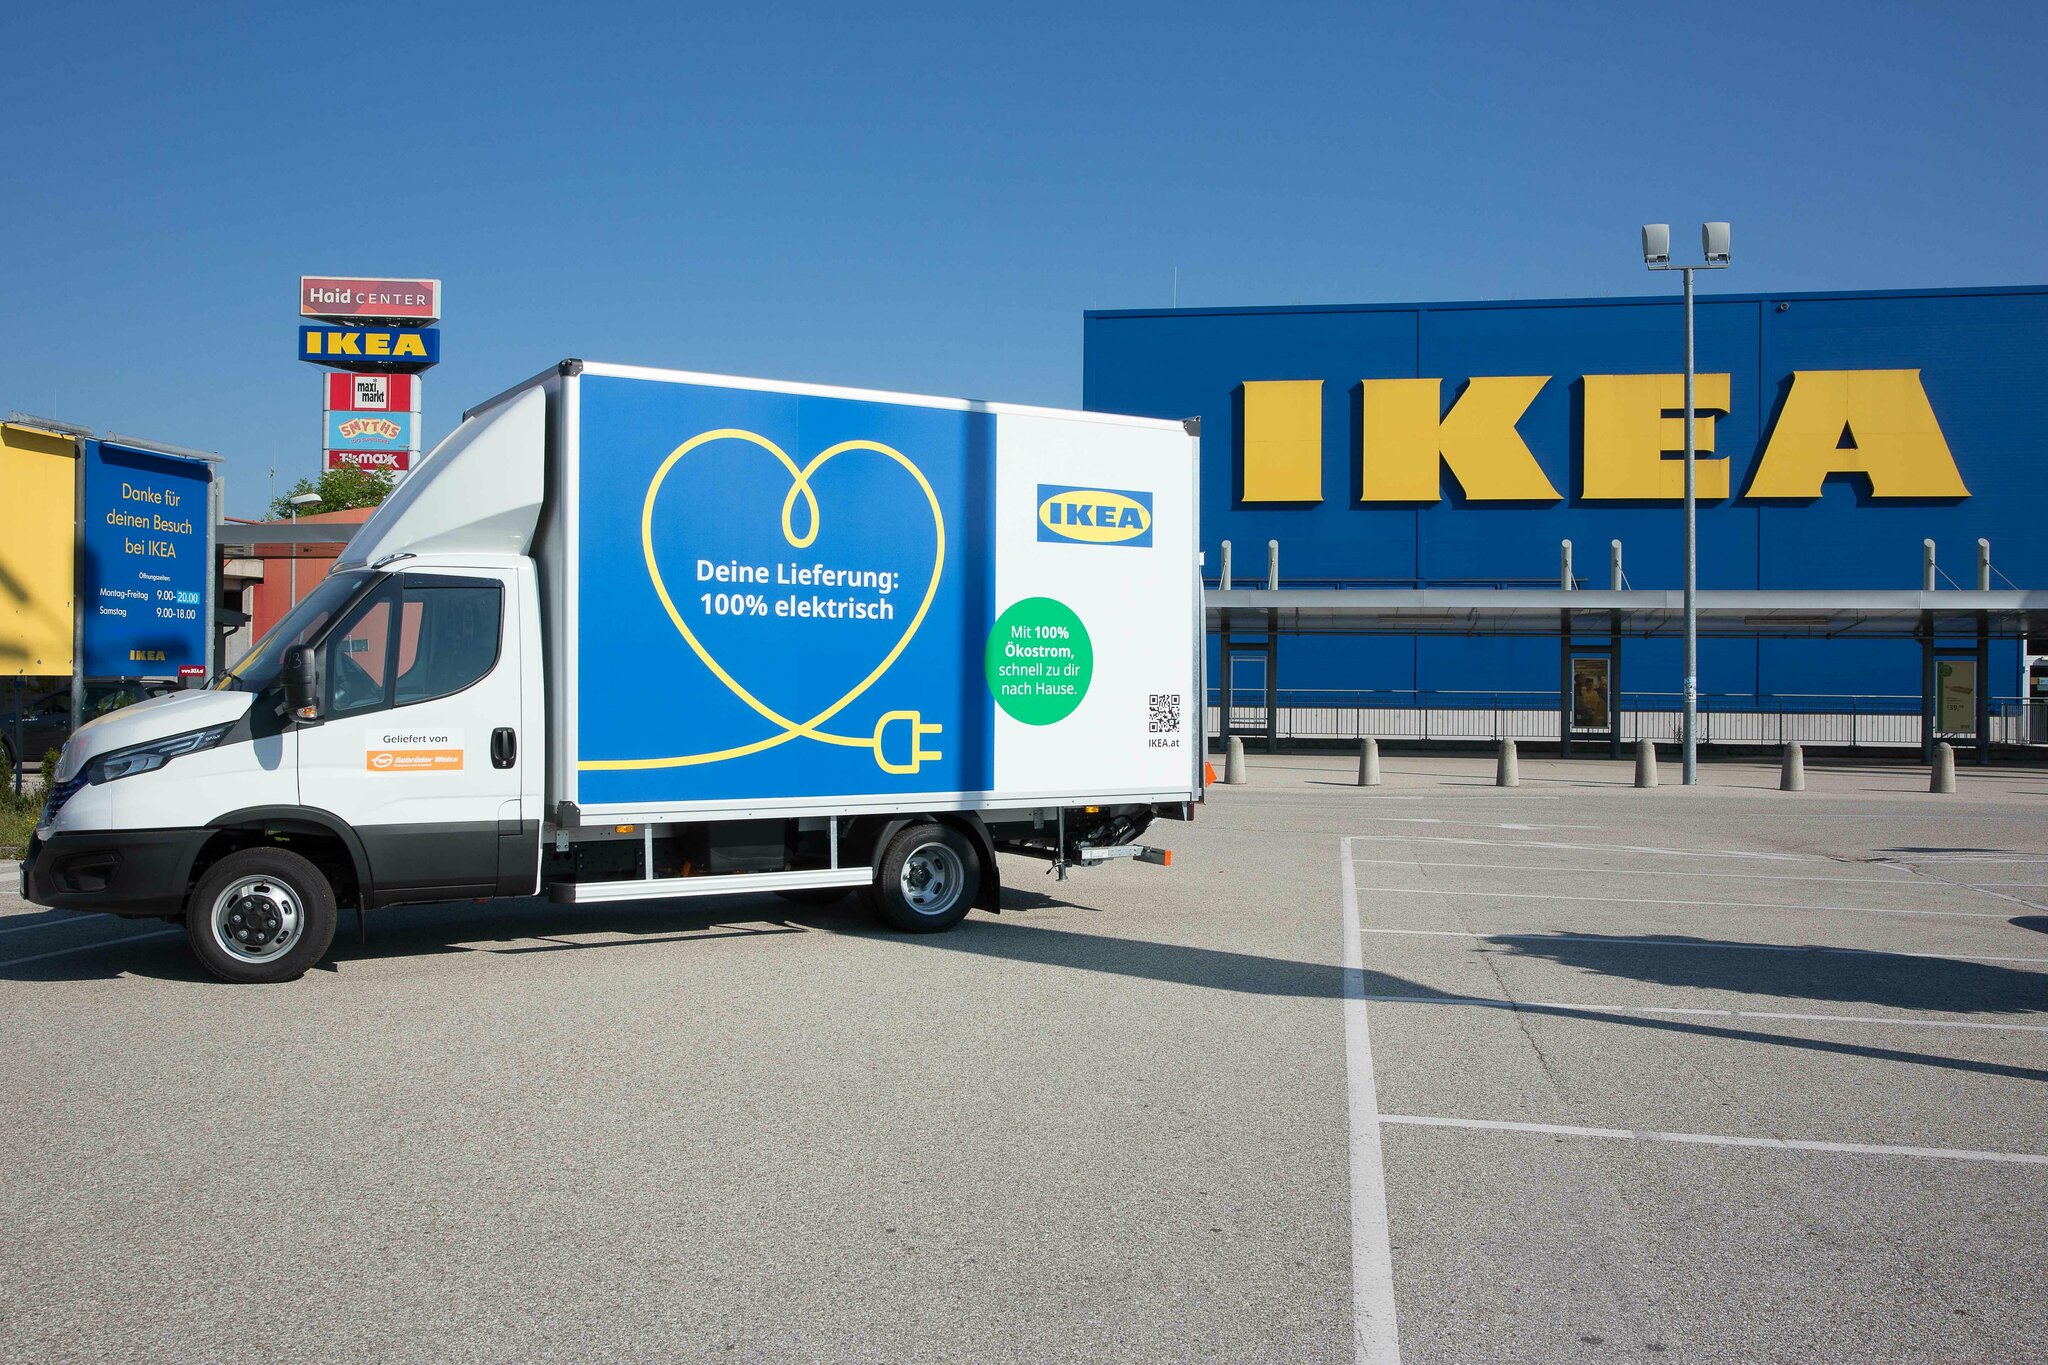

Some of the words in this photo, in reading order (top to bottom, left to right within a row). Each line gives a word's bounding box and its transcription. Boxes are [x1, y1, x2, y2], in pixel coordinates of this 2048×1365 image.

[310, 288, 351, 304] Haid
[355, 293, 426, 306] CENTER
[306, 331, 428, 357] IKEA
[357, 379, 377, 393] maxi
[361, 390, 385, 403] markt
[340, 419, 401, 438] SMYTHS
[1241, 368, 1974, 503] IKEA
[122, 482, 162, 504] Danke
[164, 489, 180, 507] für
[106, 508, 150, 529] deinen
[153, 514, 192, 535] Besuch
[1049, 502, 1144, 530] IKEA
[125, 537, 145, 555] bei
[148, 540, 177, 559] IKEA
[696, 559, 769, 584] Deine
[777, 562, 899, 595] Lieferung:
[99, 587, 149, 602] Montag-Freitag
[99, 606, 127, 618] Samstag
[156, 607, 196, 620] 9.00-18.00
[700, 593, 768, 617] 100%
[775, 595, 894, 620] elektrisch
[1011, 624, 1032, 639] Mit
[1034, 625, 1070, 639] 100%
[129, 649, 166, 661] IKEA
[1004, 641, 1075, 660] Ökostrom,
[998, 662, 1043, 677] schnell
[1045, 666, 1060, 677] zu
[1063, 663, 1080, 677] dir
[1001, 681, 1032, 695] nach
[1035, 682, 1078, 695] Hause.
[382, 734, 426, 744] Geliefert
[429, 735, 448, 743] von
[1148, 738, 1180, 748] IKEA.at
